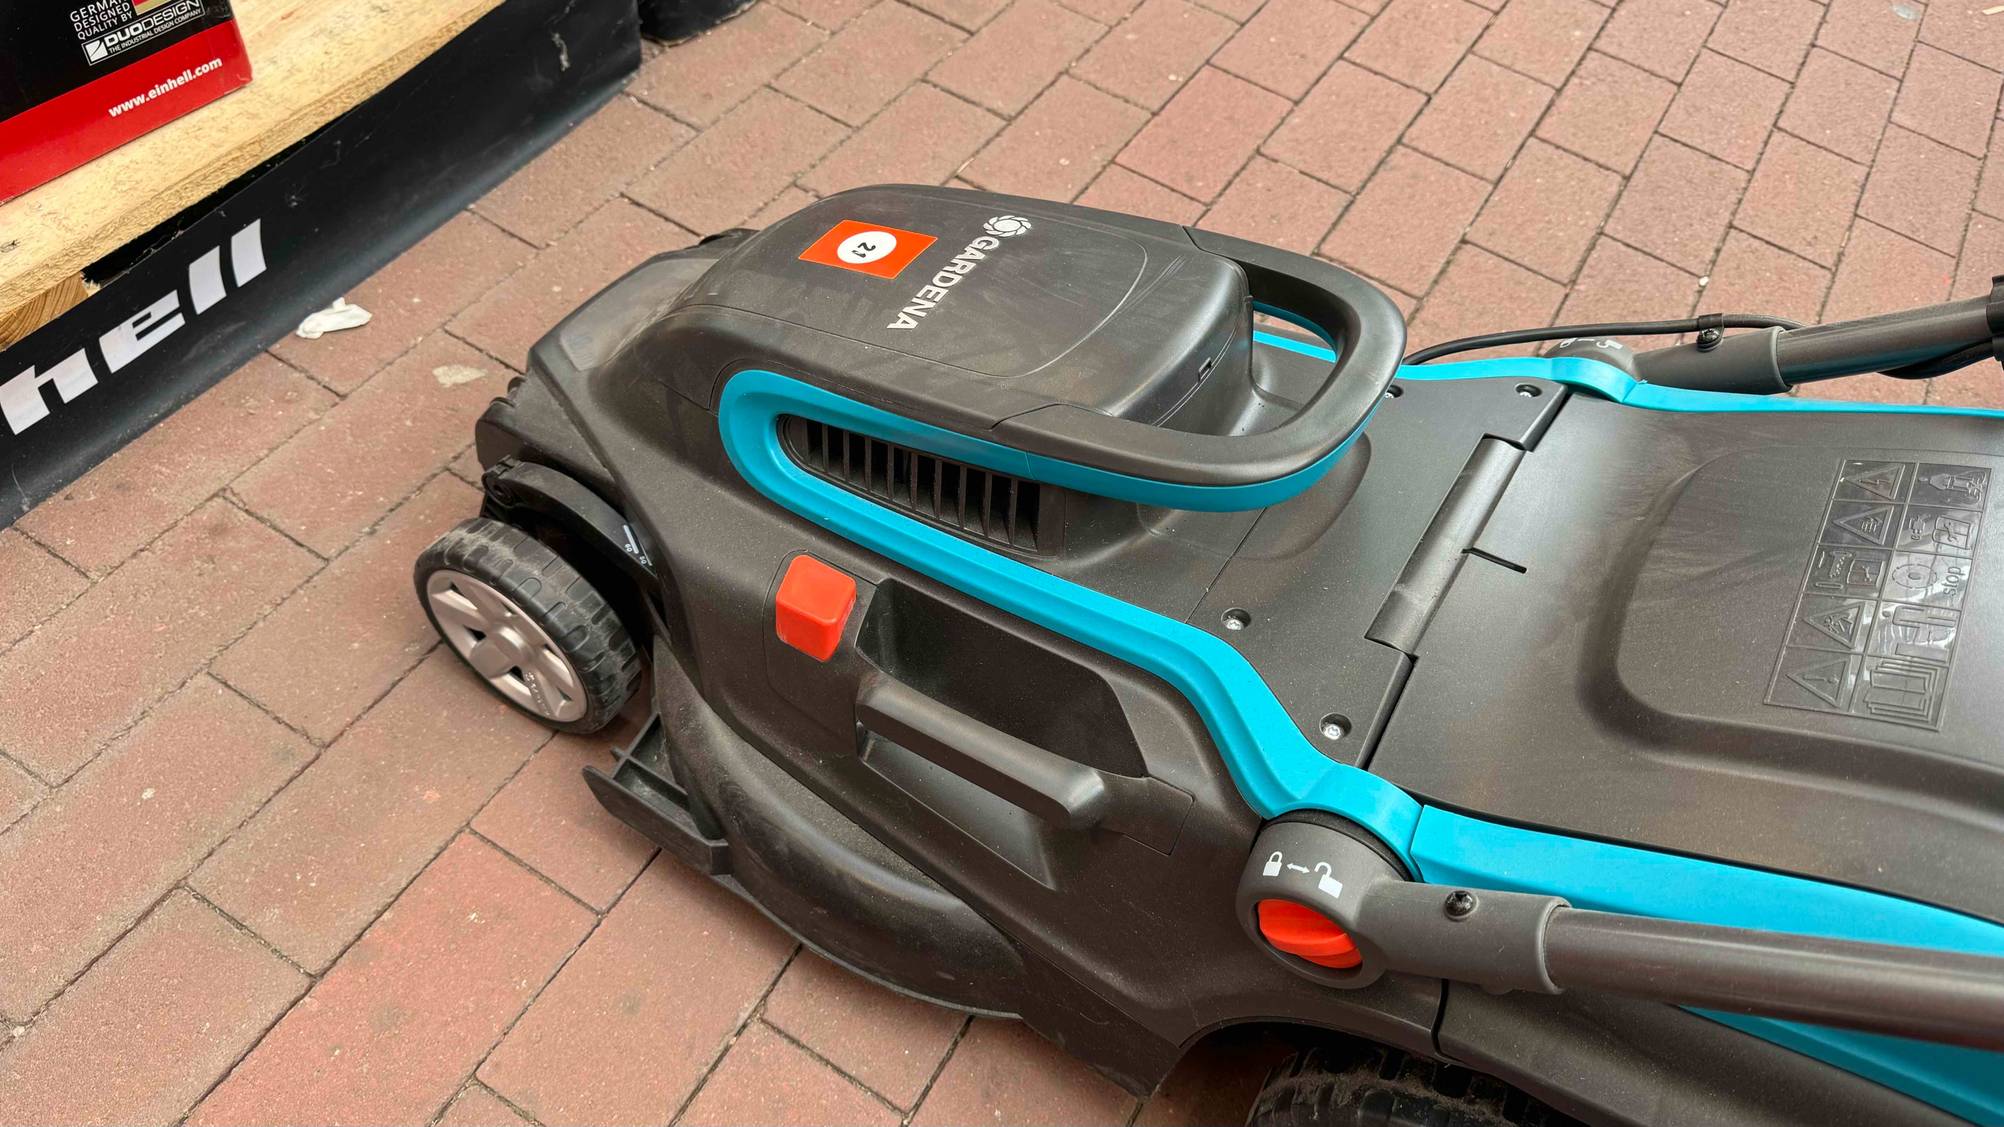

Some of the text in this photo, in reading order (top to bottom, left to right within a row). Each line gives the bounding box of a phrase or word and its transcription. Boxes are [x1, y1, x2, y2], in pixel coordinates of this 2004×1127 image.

[70, 0, 126, 21] GERMA
[74, 2, 130, 31] DESIGNED
[77, 11, 132, 40] QUALITY BY
[104, 0, 200, 47] DUODESIGN
[108, 8, 201, 54] THE INDUSTRIAL DESIGN COMPANY
[108, 57, 223, 117] www.einhell.com
[851, 242, 876, 258] 21
[887, 236, 1000, 329] GARDENA
[1942, 566, 1966, 597] stop
